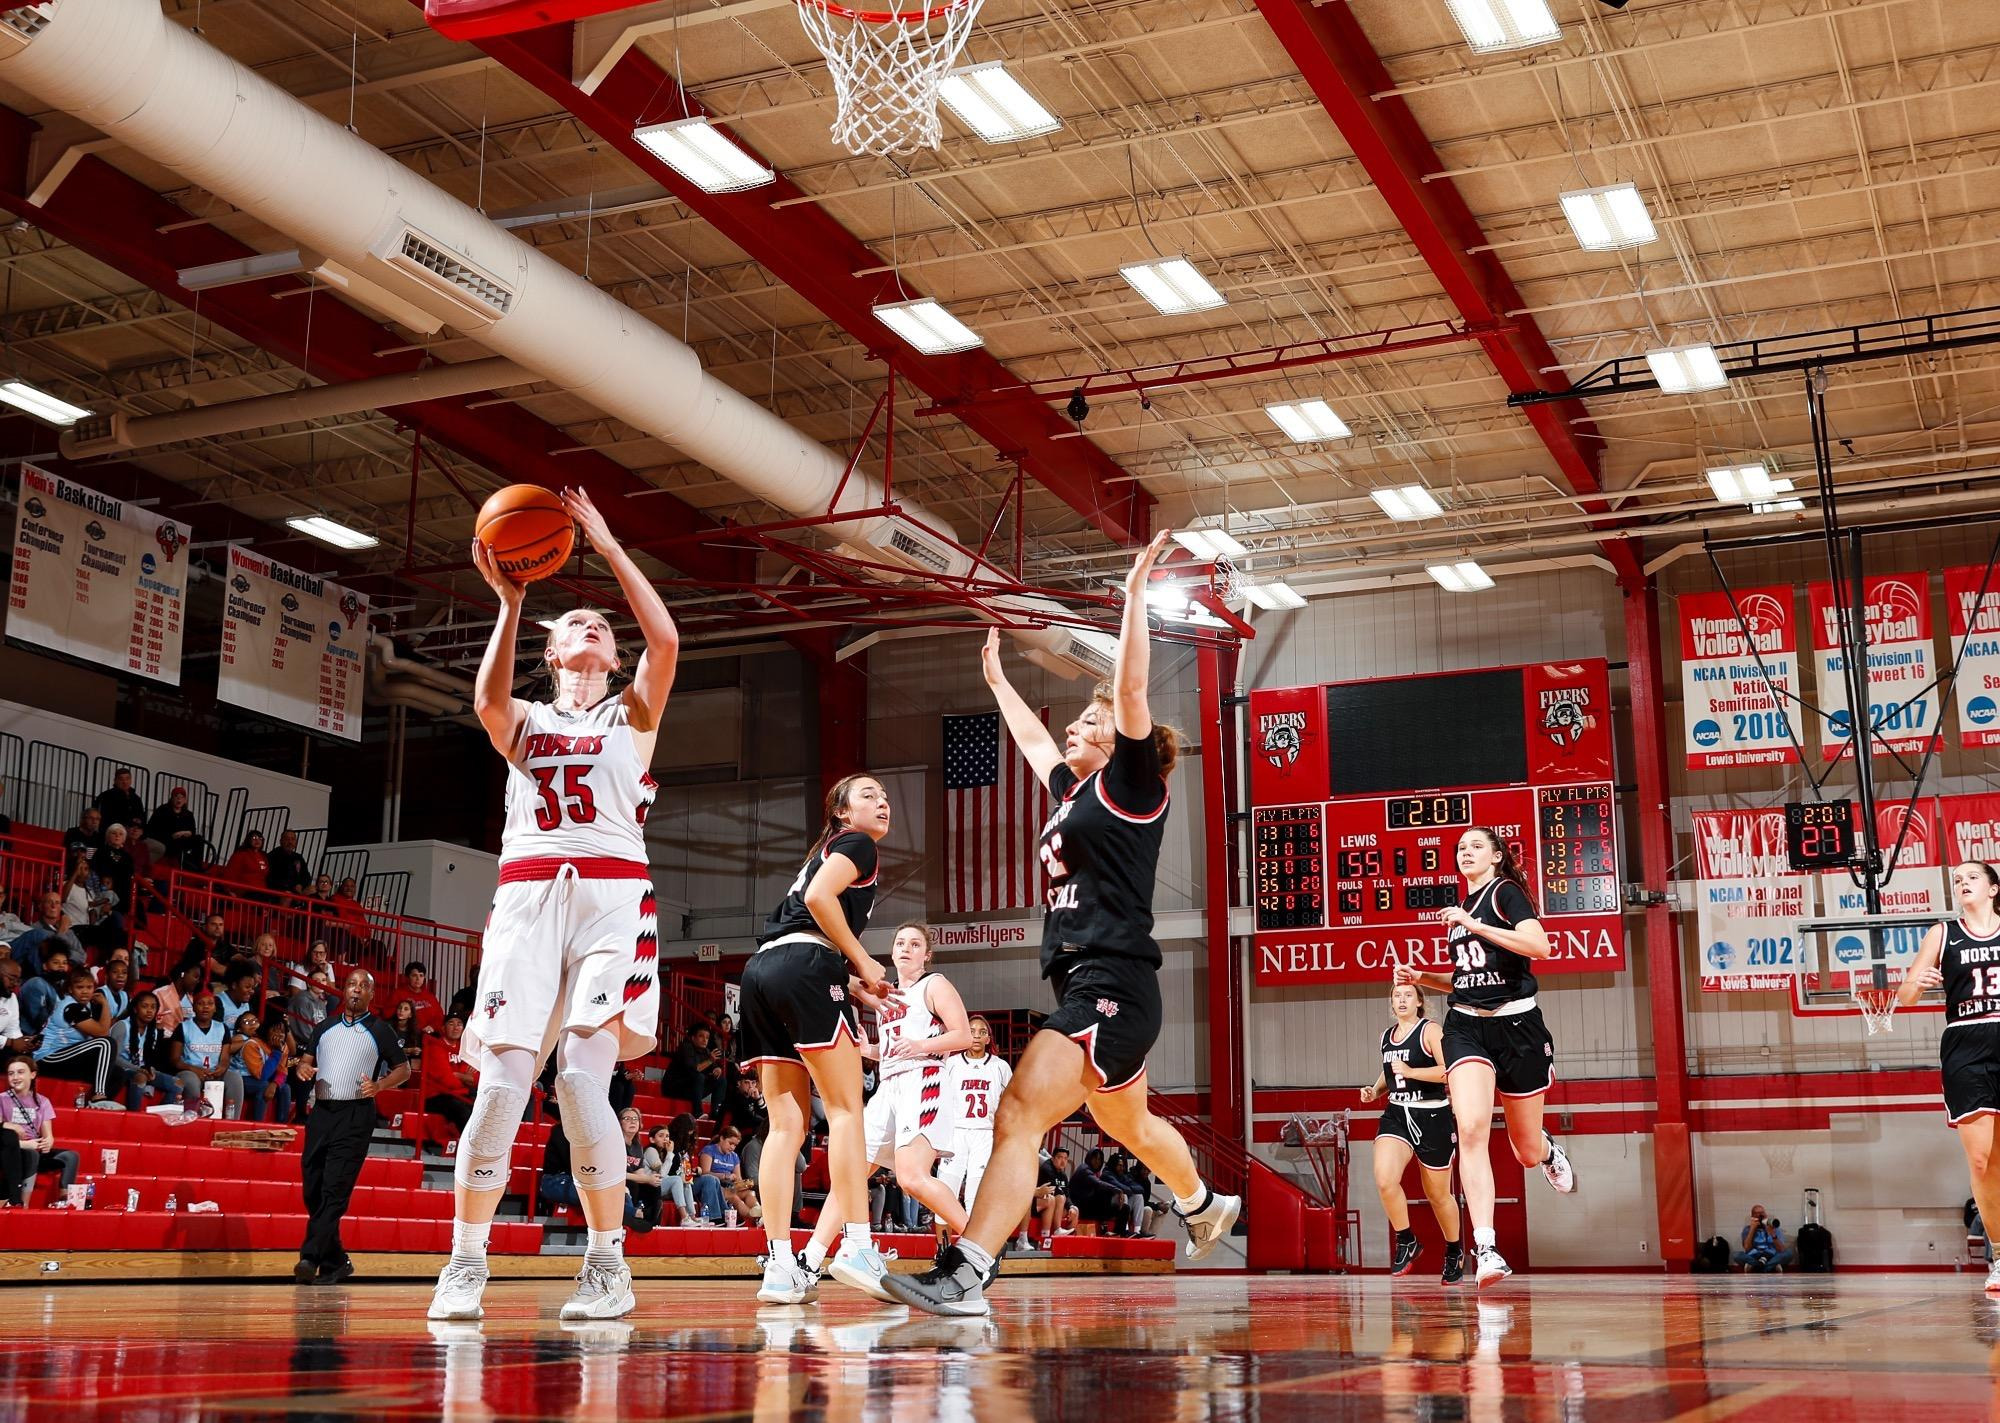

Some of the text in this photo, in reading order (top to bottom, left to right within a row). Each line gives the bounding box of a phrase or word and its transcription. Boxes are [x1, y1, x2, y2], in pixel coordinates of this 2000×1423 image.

[24, 469, 55, 495] Men's
[56, 479, 121, 521] Basketball
[22, 518, 64, 543] Conference
[20, 531, 60, 555] Champions
[84, 541, 126, 566] Tournament
[496, 547, 560, 574] Wilson
[232, 549, 269, 577] Women's
[270, 562, 324, 597] Basketball
[1915, 649, 1924, 663] II
[1964, 641, 1999, 657] NCAA
[1693, 666, 1726, 682] NCAA
[1779, 661, 1787, 675] II
[1911, 665, 1925, 679] 16
[1540, 688, 1589, 709] FLYERS
[1870, 700, 1928, 732] 2017
[1969, 708, 1998, 720] NCAA
[1260, 712, 1306, 733] FLYERS
[1696, 731, 1720, 741] NCAA
[522, 733, 608, 763] FLYERS
[1706, 751, 1785, 766] Lewis University
[530, 765, 597, 831] 35
[1541, 787, 1608, 802] PLY FL PTS
[1257, 808, 1319, 822] PLY FL PTS
[1555, 807, 1563, 820] 2
[1805, 807, 1845, 824] 2:01
[1264, 826, 1277, 840] 13
[1310, 824, 1318, 837] 6
[1489, 825, 1521, 838] UEST
[1550, 824, 1564, 838] 10
[1341, 834, 1377, 848] LEWIS
[1418, 837, 1441, 847] GAME
[1802, 825, 1840, 857] 27
[1260, 844, 1278, 857] 21
[1285, 843, 1293, 855] 0
[1551, 843, 1565, 857] 13
[1260, 859, 1319, 875] 23 0 6
[1348, 851, 1380, 877] 55
[1426, 850, 1436, 870] 3
[1547, 861, 1566, 875] 22
[1261, 879, 1279, 892] 35
[1301, 876, 1320, 890] 20
[1337, 881, 1363, 891] FOULS
[1372, 879, 1395, 889] T.O.L.
[1403, 875, 1460, 887] PLAYER FOUL
[1548, 879, 1568, 893] 40
[1261, 895, 1320, 910] 42 0 2
[1348, 893, 1360, 909] 4
[1380, 889, 1390, 909] 3
[1709, 887, 1744, 903] NCAA
[1839, 894, 1867, 909] NCA
[1343, 915, 1362, 925] WON
[1418, 911, 1442, 921] MATC
[702, 945, 715, 957] EXIT
[1260, 929, 1618, 973] NEIL CARE ENA
[1456, 940, 1486, 971] 40
[1839, 949, 1864, 958] NCAA
[1972, 967, 2000, 996] 13
[203, 1056, 210, 1069] 4
[966, 1093, 988, 1118] 23
